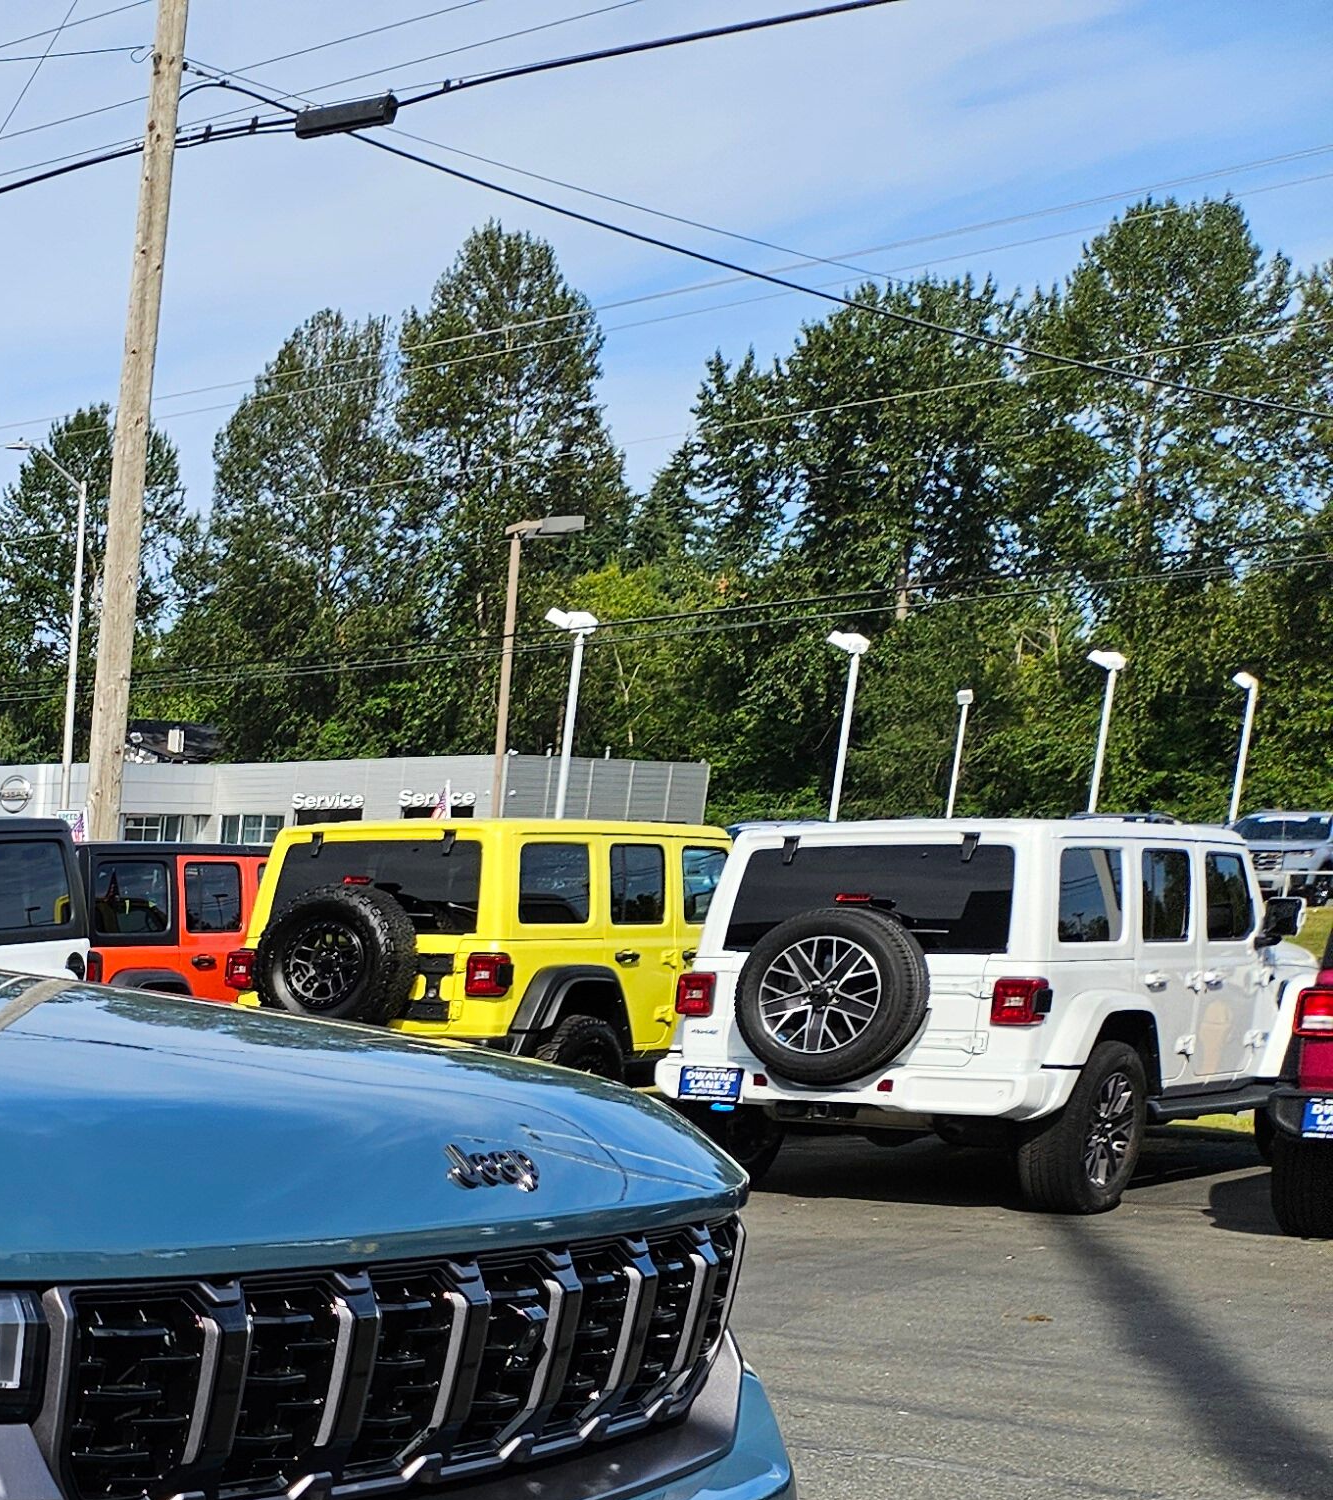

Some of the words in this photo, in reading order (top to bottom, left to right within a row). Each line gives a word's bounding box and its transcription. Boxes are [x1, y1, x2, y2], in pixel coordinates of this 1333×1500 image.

[290, 791, 365, 810] Service
[685, 1070, 737, 1081] DWAYNE
[443, 1142, 539, 1193] Jeep
